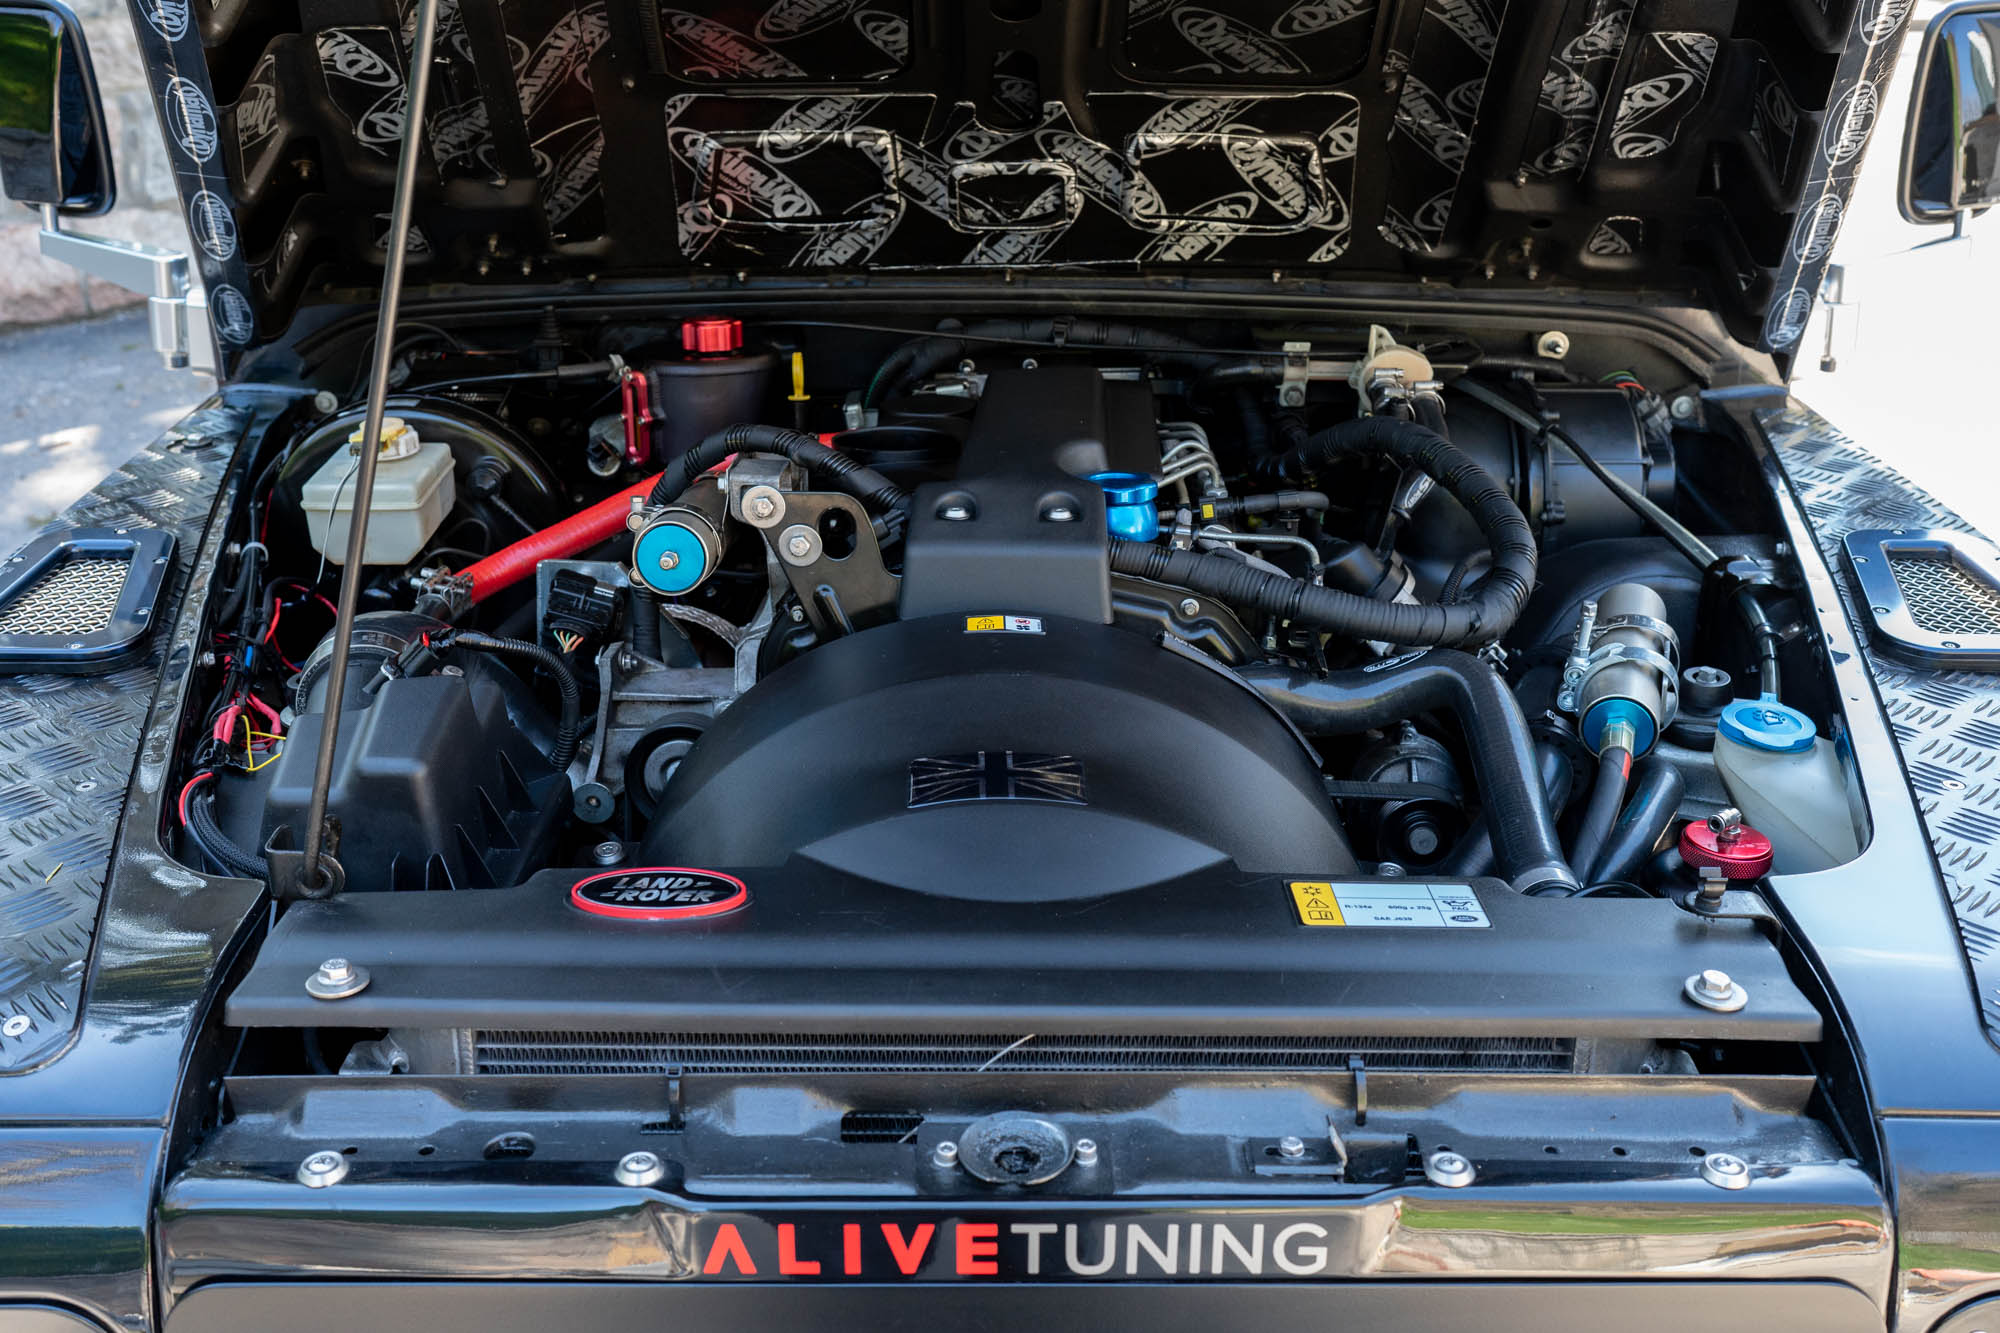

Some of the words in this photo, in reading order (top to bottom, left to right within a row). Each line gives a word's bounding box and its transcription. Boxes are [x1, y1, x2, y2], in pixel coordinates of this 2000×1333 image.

[173, 85, 214, 148] Dynamat
[612, 877, 694, 889] LAND
[615, 889, 716, 902] ROVER
